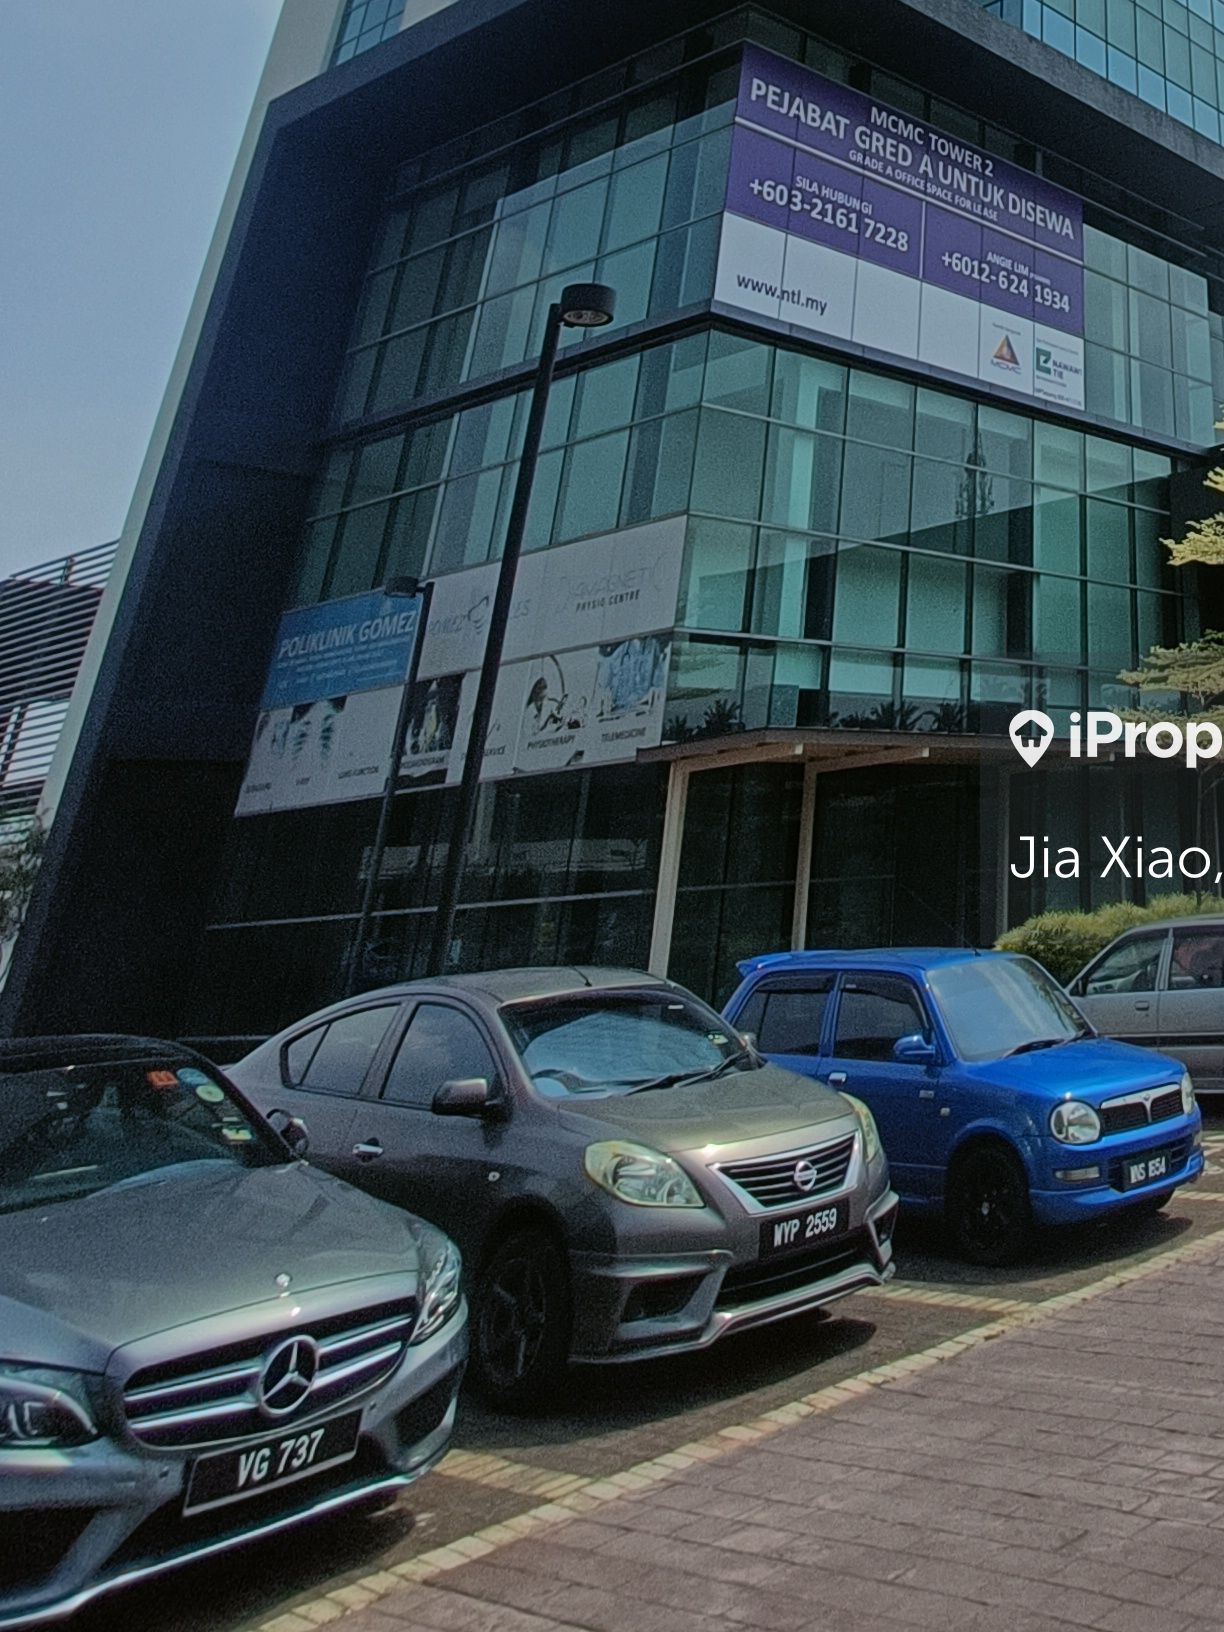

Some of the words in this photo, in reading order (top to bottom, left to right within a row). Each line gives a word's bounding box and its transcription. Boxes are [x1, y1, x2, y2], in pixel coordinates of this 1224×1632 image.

[751, 78, 850, 139] PEJABAT
[854, 125, 913, 167] GRED
[918, 154, 934, 179] A
[938, 160, 1005, 210] UNTUK
[1008, 192, 1075, 241] DISEWA
[870, 106, 924, 144] MCMC
[929, 133, 982, 172] TOWER
[984, 160, 994, 178] 2
[795, 175, 819, 196] SILA
[821, 185, 873, 216] HUBUNGI
[849, 150, 884, 172] GRADE
[885, 166, 893, 177] A
[894, 169, 925, 191] OFFICE
[926, 181, 953, 202] SPACE
[954, 194, 972, 212] FOR
[750, 178, 859, 234] +603-2161
[863, 217, 909, 252] 7228
[986, 251, 1013, 270] ANGIE
[1013, 261, 1029, 277] LIM
[736, 273, 828, 317] www.ntl.my
[1034, 283, 1070, 313] 1934
[608, 588, 641, 607] CENTRE
[276, 623, 358, 660] POLIKLINIK
[358, 610, 417, 643] GOMEZ
[773, 1218, 801, 1248] WYP
[805, 1207, 838, 1238] 2559
[237, 1447, 272, 1488] VG
[276, 1427, 326, 1475] 737
